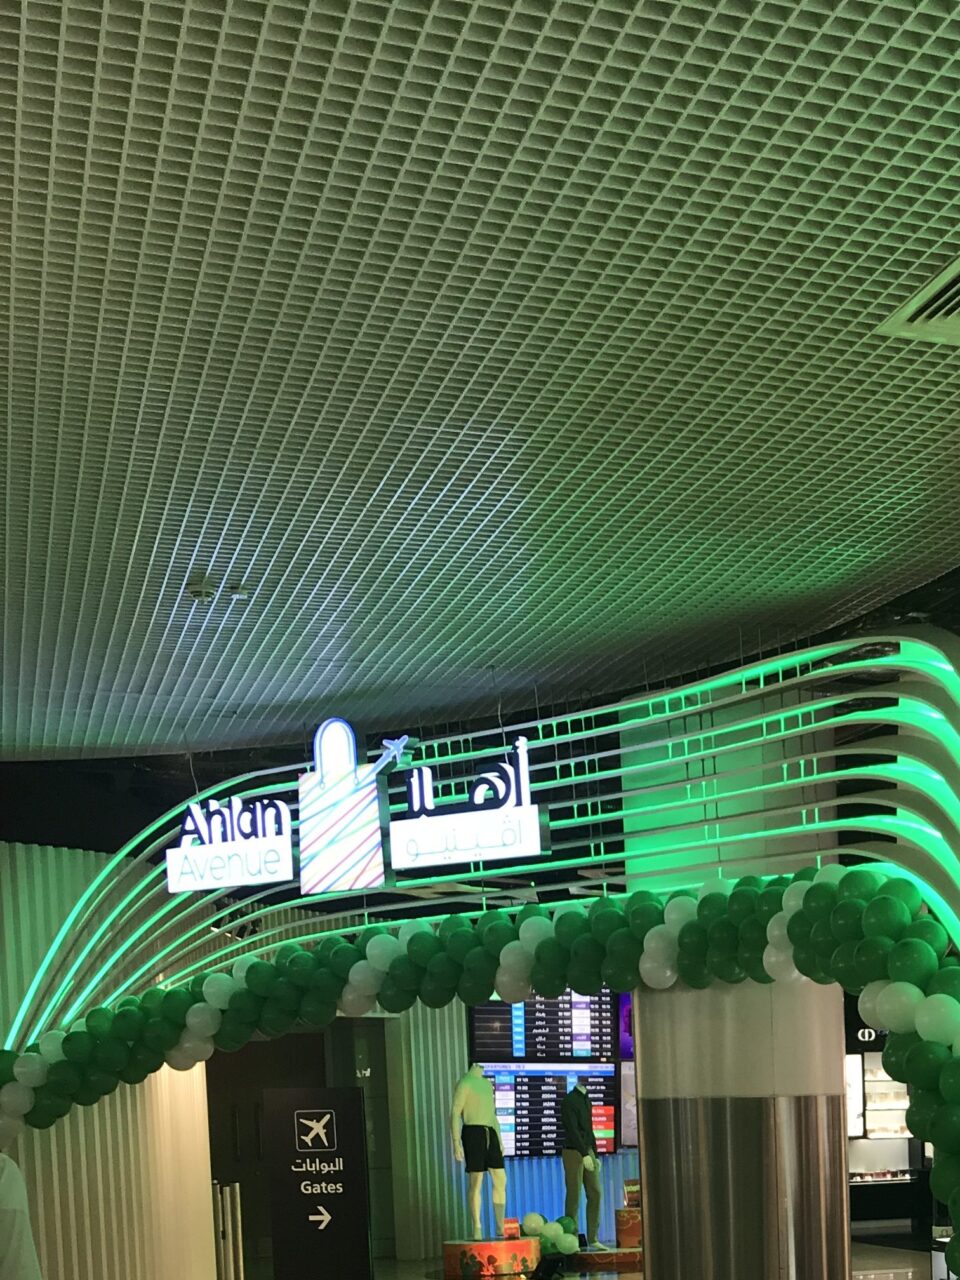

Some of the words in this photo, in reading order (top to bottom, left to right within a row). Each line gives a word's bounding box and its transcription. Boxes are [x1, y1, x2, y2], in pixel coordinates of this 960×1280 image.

[179, 797, 288, 848] Ahlan
[177, 848, 281, 883] Avenue
[291, 1157, 344, 1174] البوابات
[300, 1181, 344, 1194] Gates
